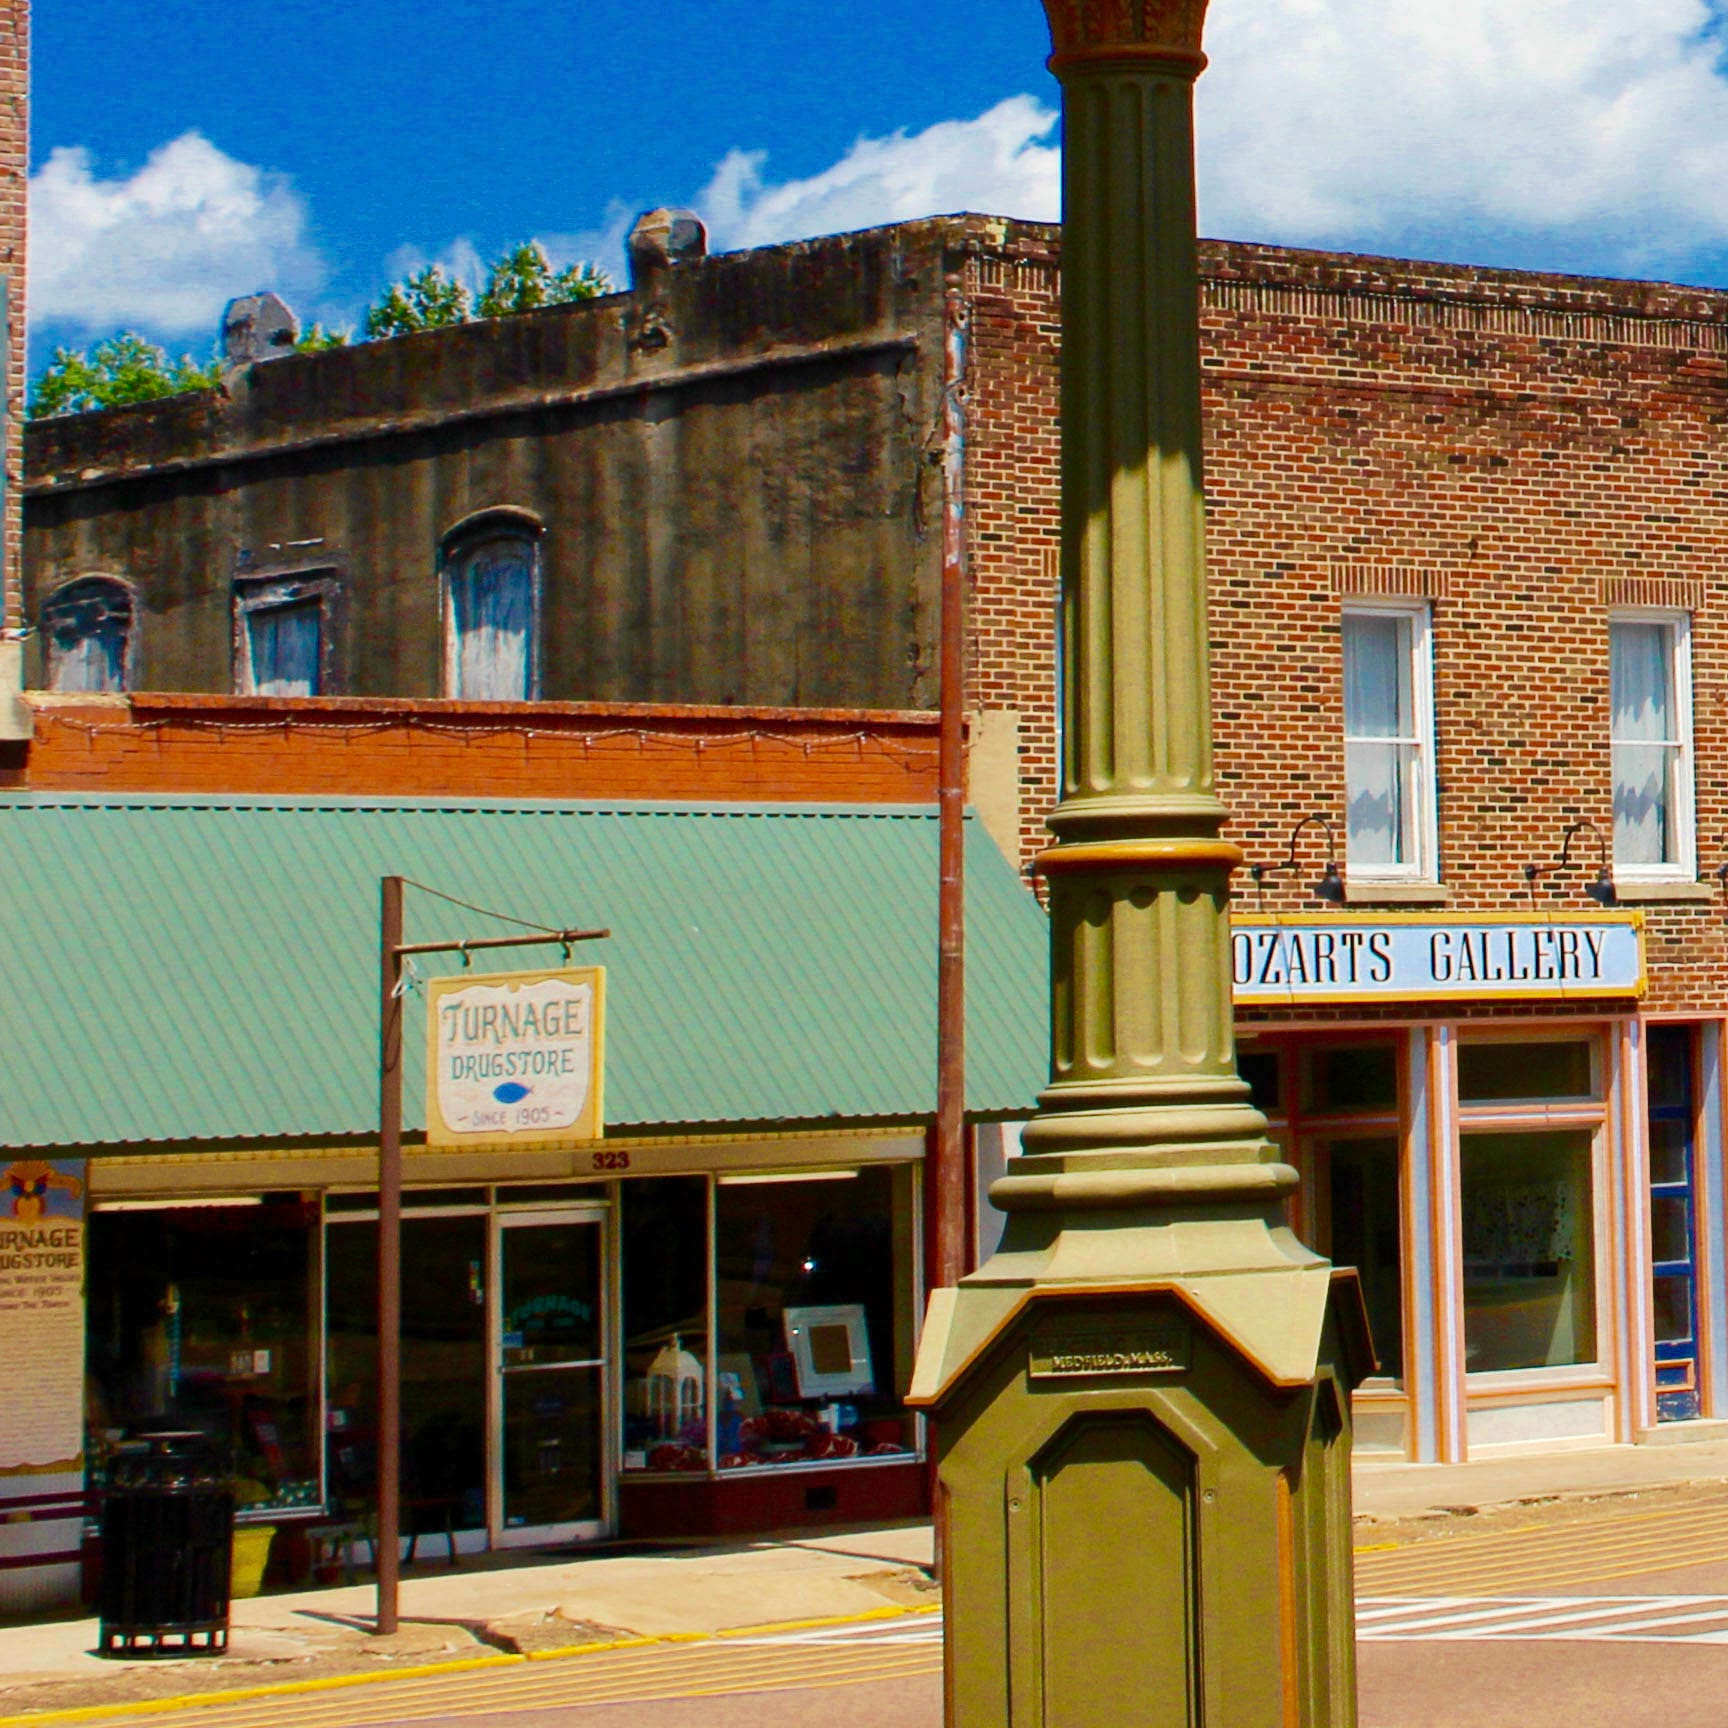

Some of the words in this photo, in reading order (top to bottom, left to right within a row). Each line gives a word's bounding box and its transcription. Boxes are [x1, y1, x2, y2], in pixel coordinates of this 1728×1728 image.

[1232, 932, 1391, 985] OZARTS
[1429, 929, 1606, 981] GALLERY
[443, 999, 583, 1045] TURNAGE
[452, 1049, 575, 1082] DRUGSTORE
[515, 1106, 551, 1126] 1905
[591, 1151, 631, 1170] 323
